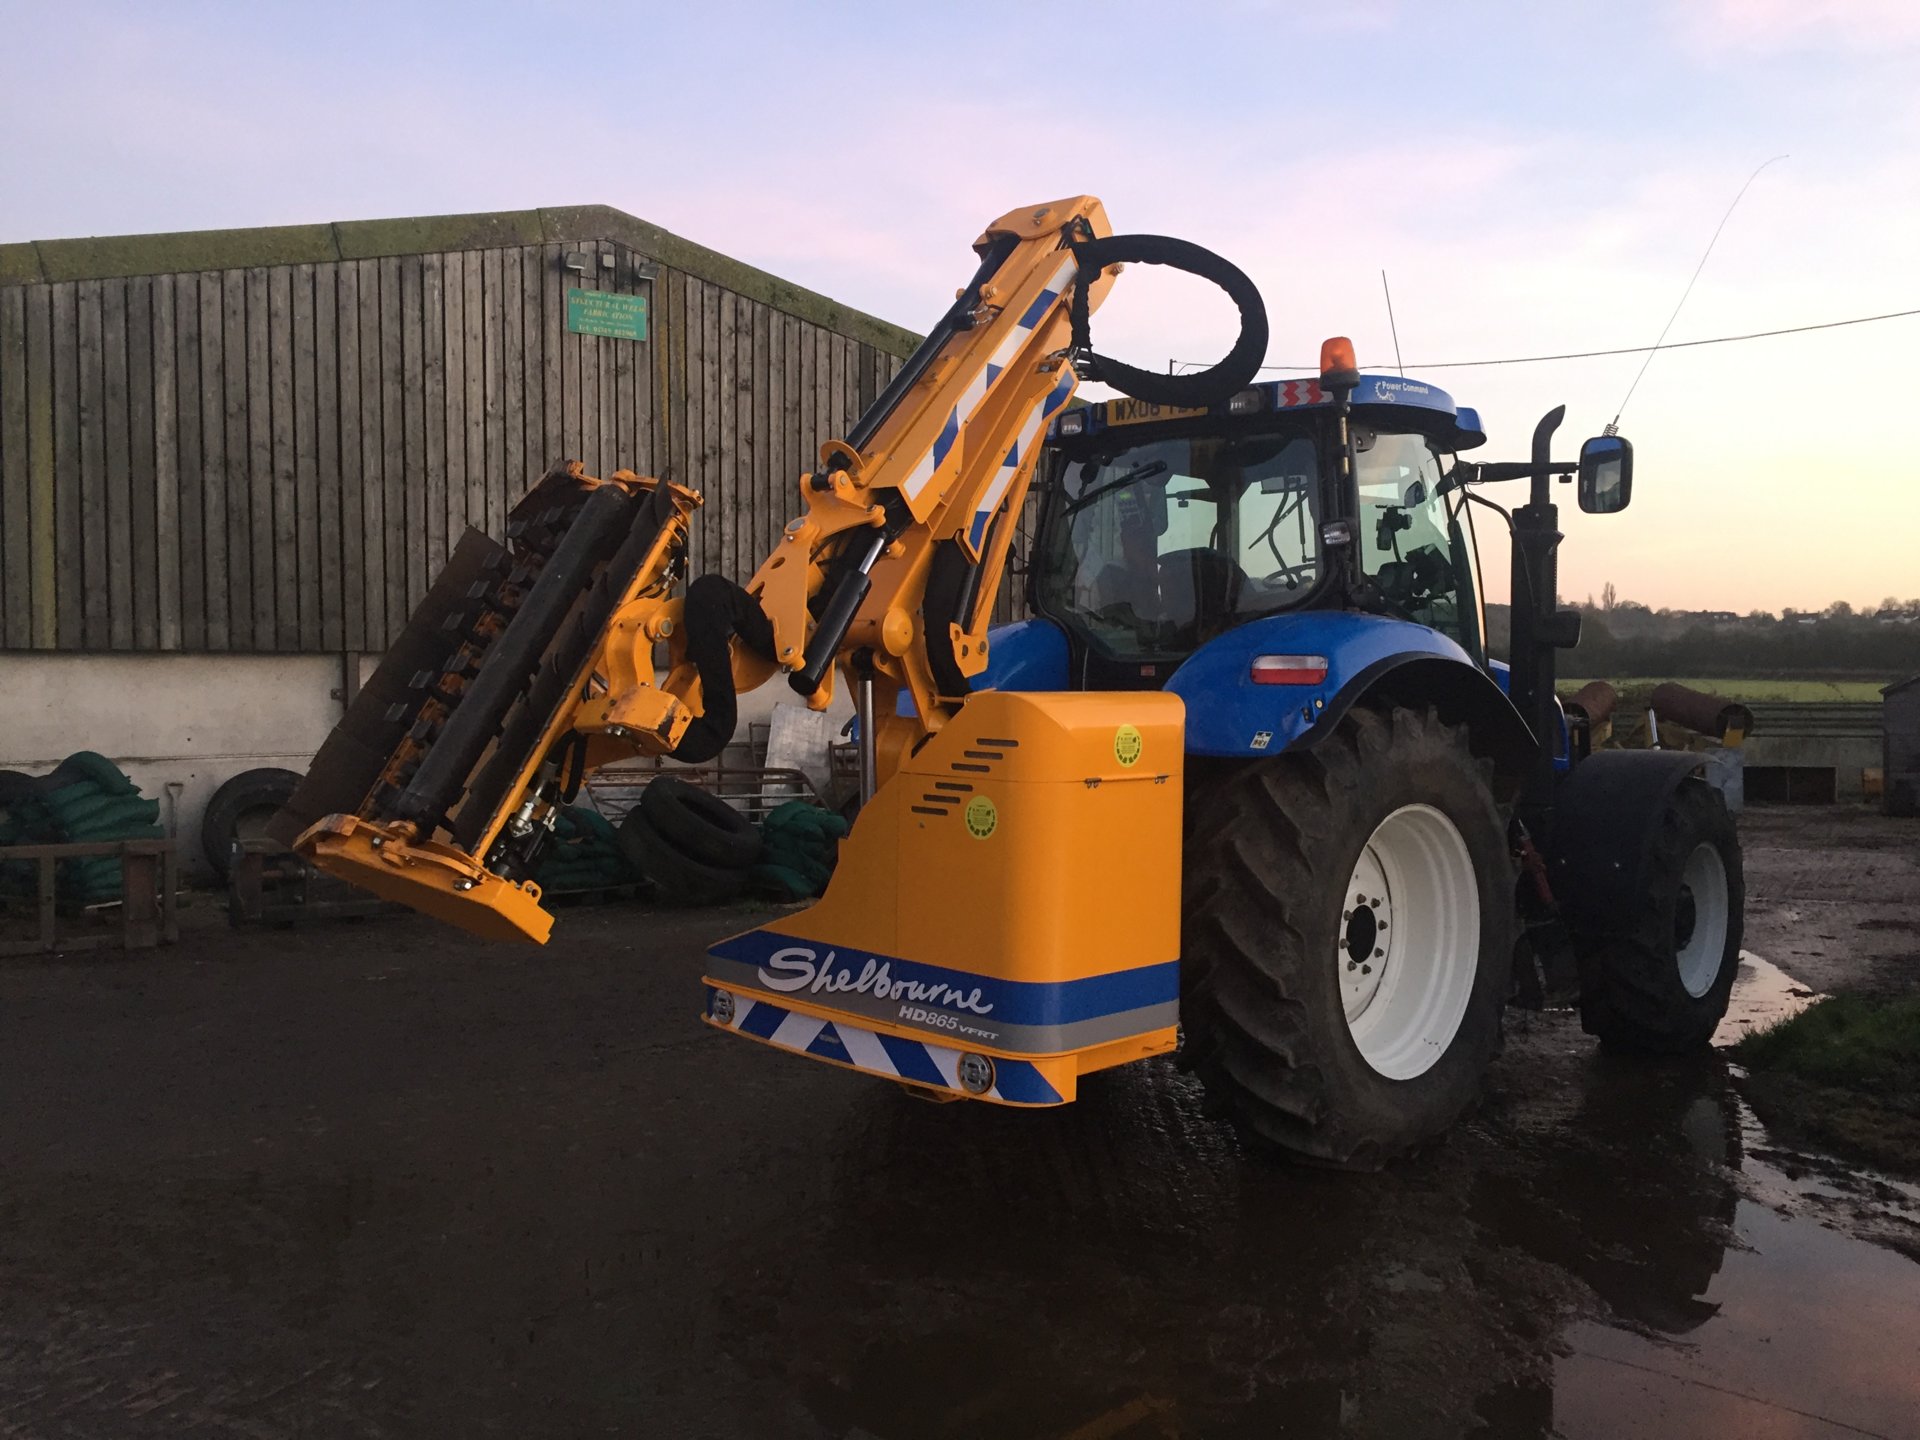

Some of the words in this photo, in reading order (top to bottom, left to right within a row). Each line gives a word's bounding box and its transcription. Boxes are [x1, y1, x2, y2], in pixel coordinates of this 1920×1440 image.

[583, 308, 633, 320] FABRICATION
[1382, 381, 1401, 391] Power
[1402, 382, 1429, 394] Command
[757, 947, 994, 1014] Shelbourne
[898, 1004, 959, 1030] HD865
[958, 1024, 1000, 1040] VFRT
